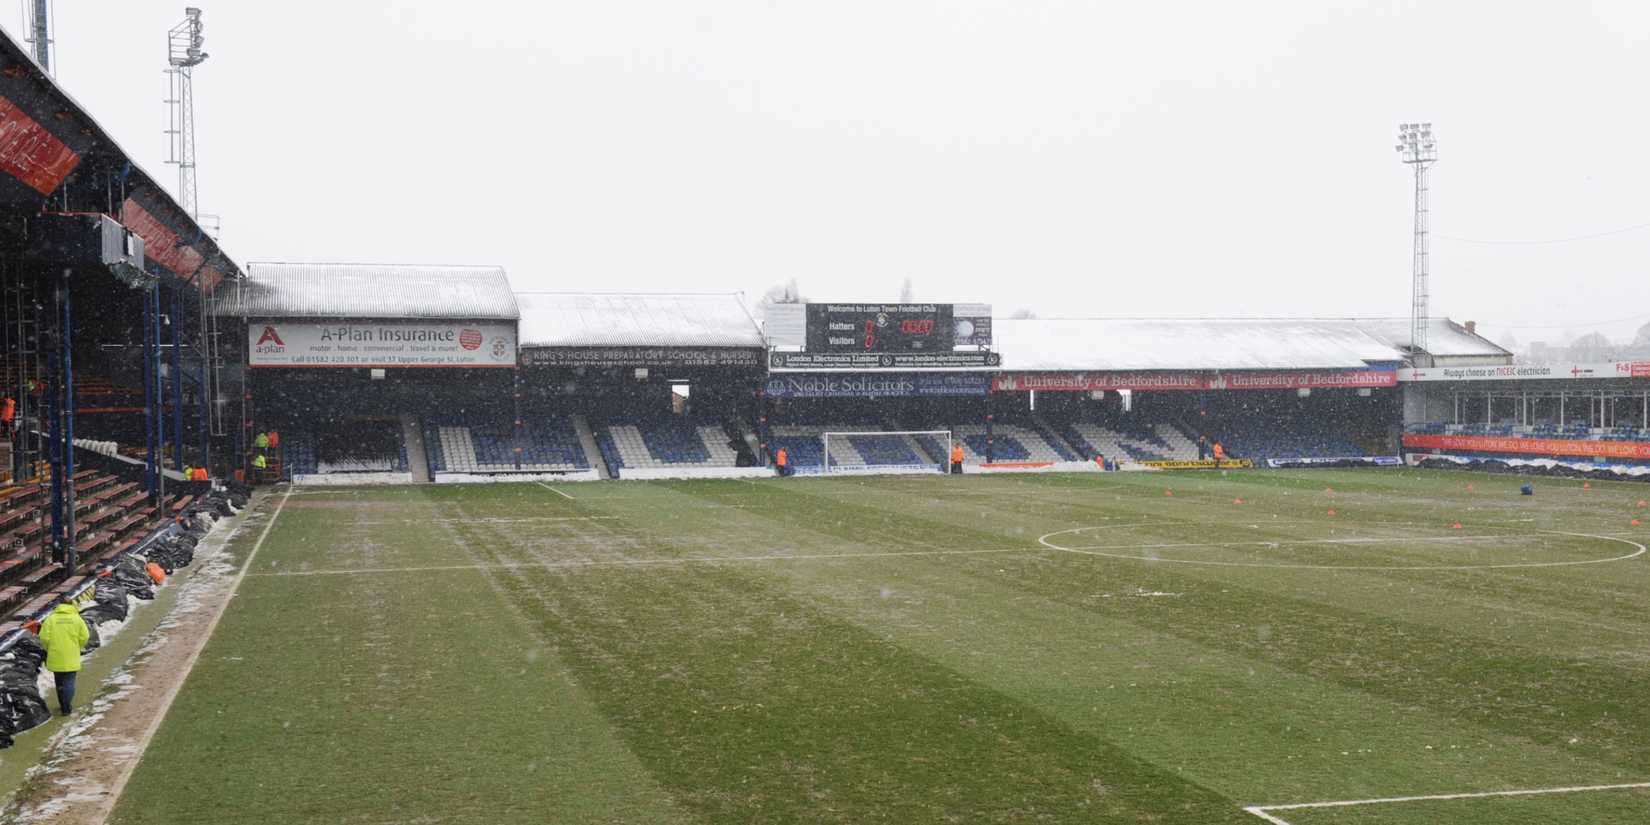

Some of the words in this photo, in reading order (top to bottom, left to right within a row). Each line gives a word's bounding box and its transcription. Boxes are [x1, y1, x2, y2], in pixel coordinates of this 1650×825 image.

[828, 305, 855, 313] Welcome
[856, 305, 863, 313] to
[863, 305, 880, 313] Luton
[882, 305, 898, 313] Town
[898, 305, 922, 313] Football
[923, 305, 936, 313] Club
[829, 322, 855, 330] Hatters
[321, 326, 373, 341] A-Plan
[379, 326, 455, 341] Insurance
[829, 336, 855, 345] Visitors
[256, 344, 285, 353] a-plan
[567, 351, 599, 360] HOUSE
[603, 351, 664, 360] PREPARATORY
[786, 354, 812, 362] London
[813, 354, 851, 362] Electronics
[852, 354, 879, 362] Limited
[1443, 368, 1465, 379] Always
[1465, 368, 1486, 377] choose
[1517, 366, 1551, 376] electrician
[788, 376, 839, 391] Noble
[841, 376, 914, 391] Solicitors
[1024, 375, 1090, 389] University
[1095, 375, 1108, 386] of
[1111, 375, 1195, 387] Bedfordshire
[1233, 373, 1296, 388] University
[1298, 373, 1310, 385] of
[1311, 372, 1391, 386] Bedfordshire
